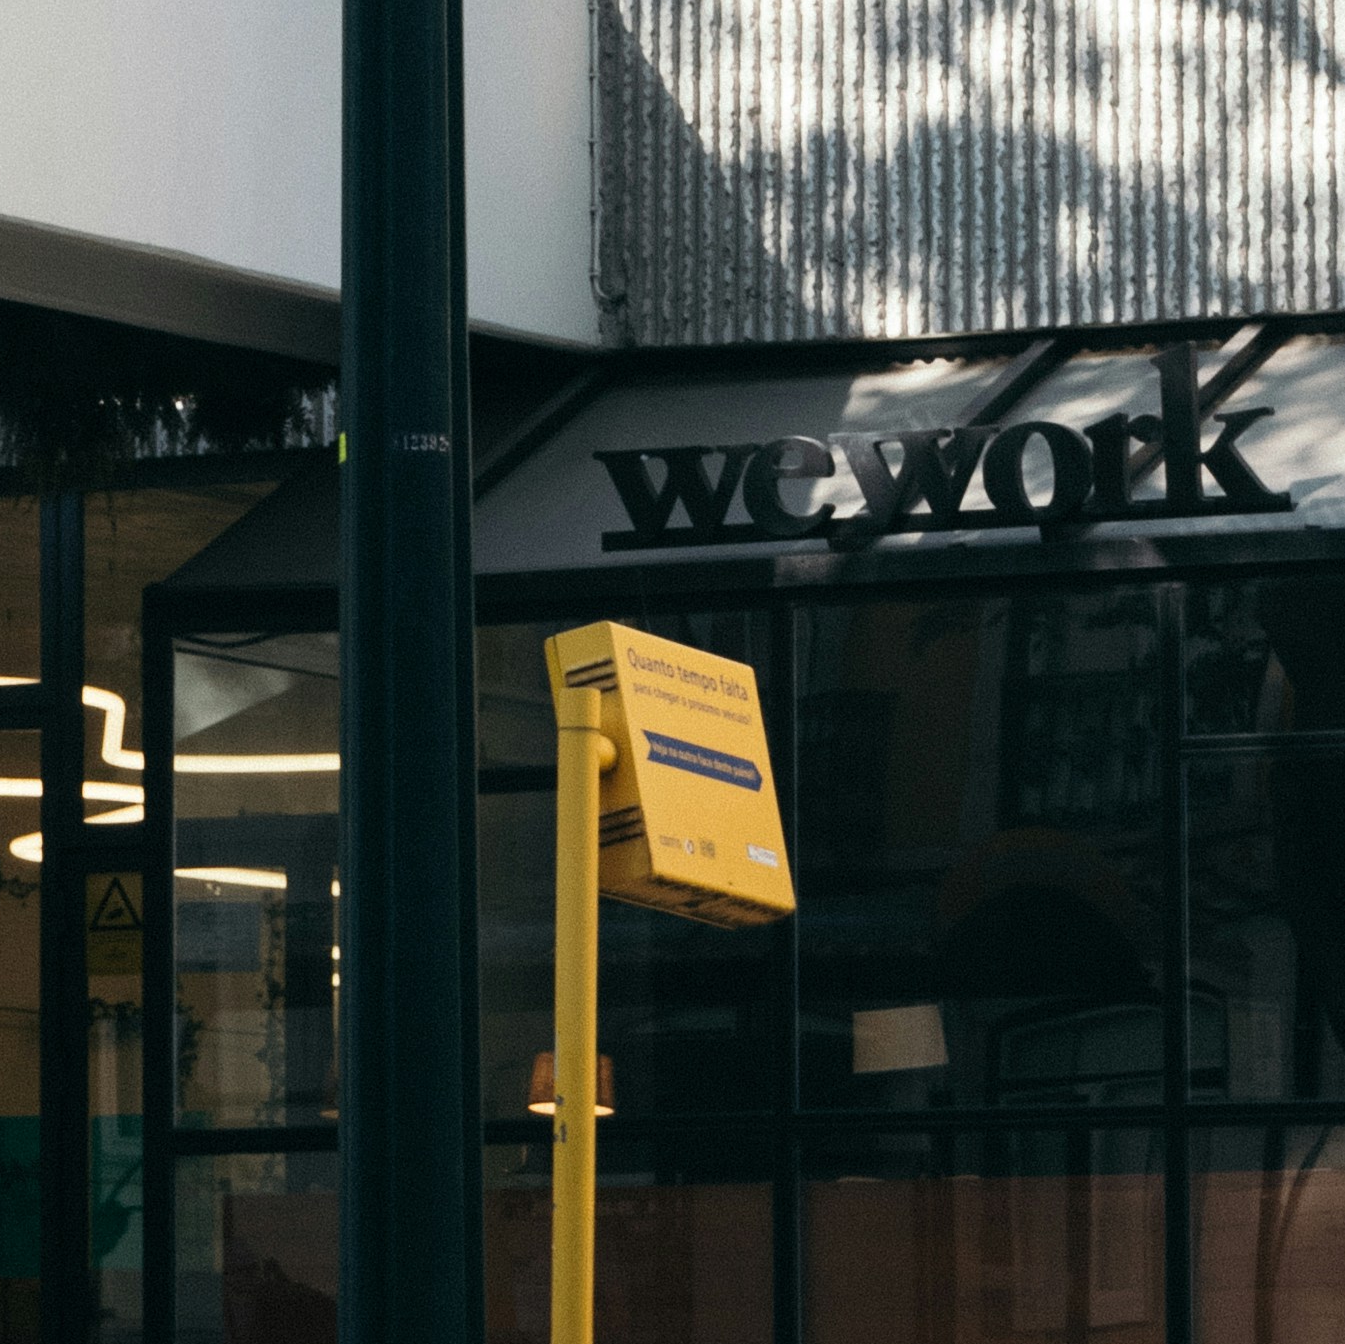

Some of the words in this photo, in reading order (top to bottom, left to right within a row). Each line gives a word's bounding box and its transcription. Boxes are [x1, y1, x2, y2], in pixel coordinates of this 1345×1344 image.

[593, 341, 1292, 539] wework
[627, 647, 675, 678] Quanto
[677, 664, 717, 693] tempo
[720, 674, 748, 701] falta
